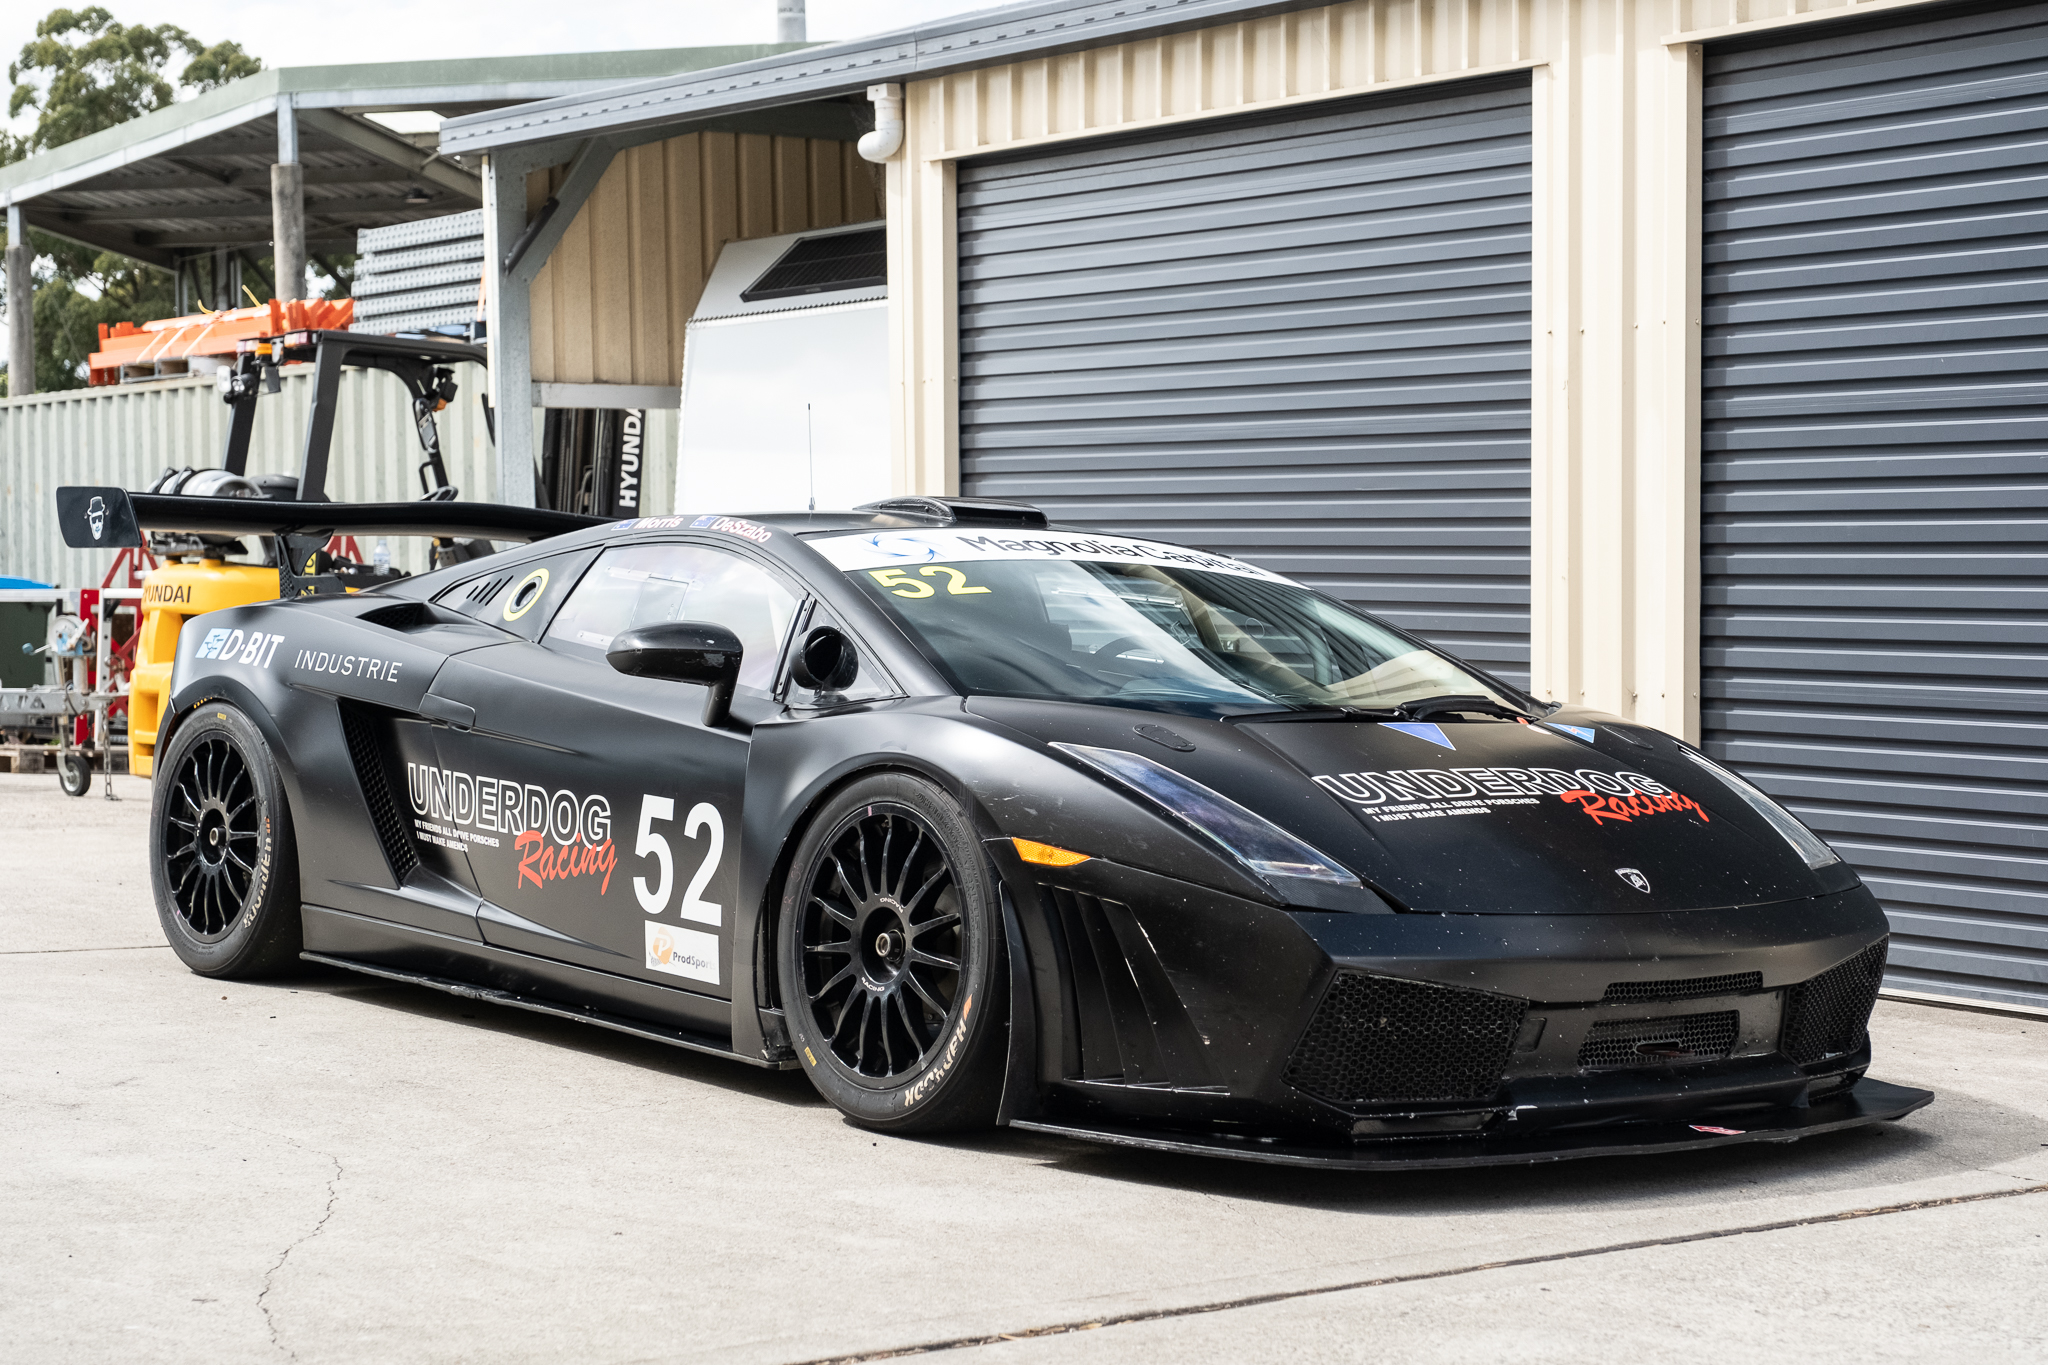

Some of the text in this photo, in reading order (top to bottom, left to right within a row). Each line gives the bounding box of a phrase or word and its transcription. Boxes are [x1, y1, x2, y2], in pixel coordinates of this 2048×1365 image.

[619, 408, 642, 507] HYUNDA
[634, 516, 773, 543] Morris DeSzabo
[956, 535, 1267, 576] Magnolia Capital
[143, 585, 191, 603] YUNDAI
[868, 565, 992, 599] 52
[295, 650, 402, 683] INDUSTRIE
[1311, 767, 1675, 804] UNDERDOG
[407, 762, 612, 851] UNDERDOG
[1362, 807, 1380, 815] MY
[1382, 803, 1430, 813] FRIENDS
[1431, 801, 1452, 809] ALL
[1452, 799, 1486, 807] DRIVE
[1380, 812, 1412, 821] MUST
[1412, 809, 1446, 818] MAKE
[1447, 807, 1491, 815] AMENDS
[1560, 789, 1710, 826] Racing
[414, 819, 422, 828] MY
[422, 821, 442, 834] FRIENDS
[442, 826, 452, 836] ALL
[470, 833, 499, 847] PORSCHES
[419, 831, 431, 842] MUST
[432, 835, 446, 846] MAKE
[514, 830, 618, 896] Racing
[633, 794, 724, 927] 52
